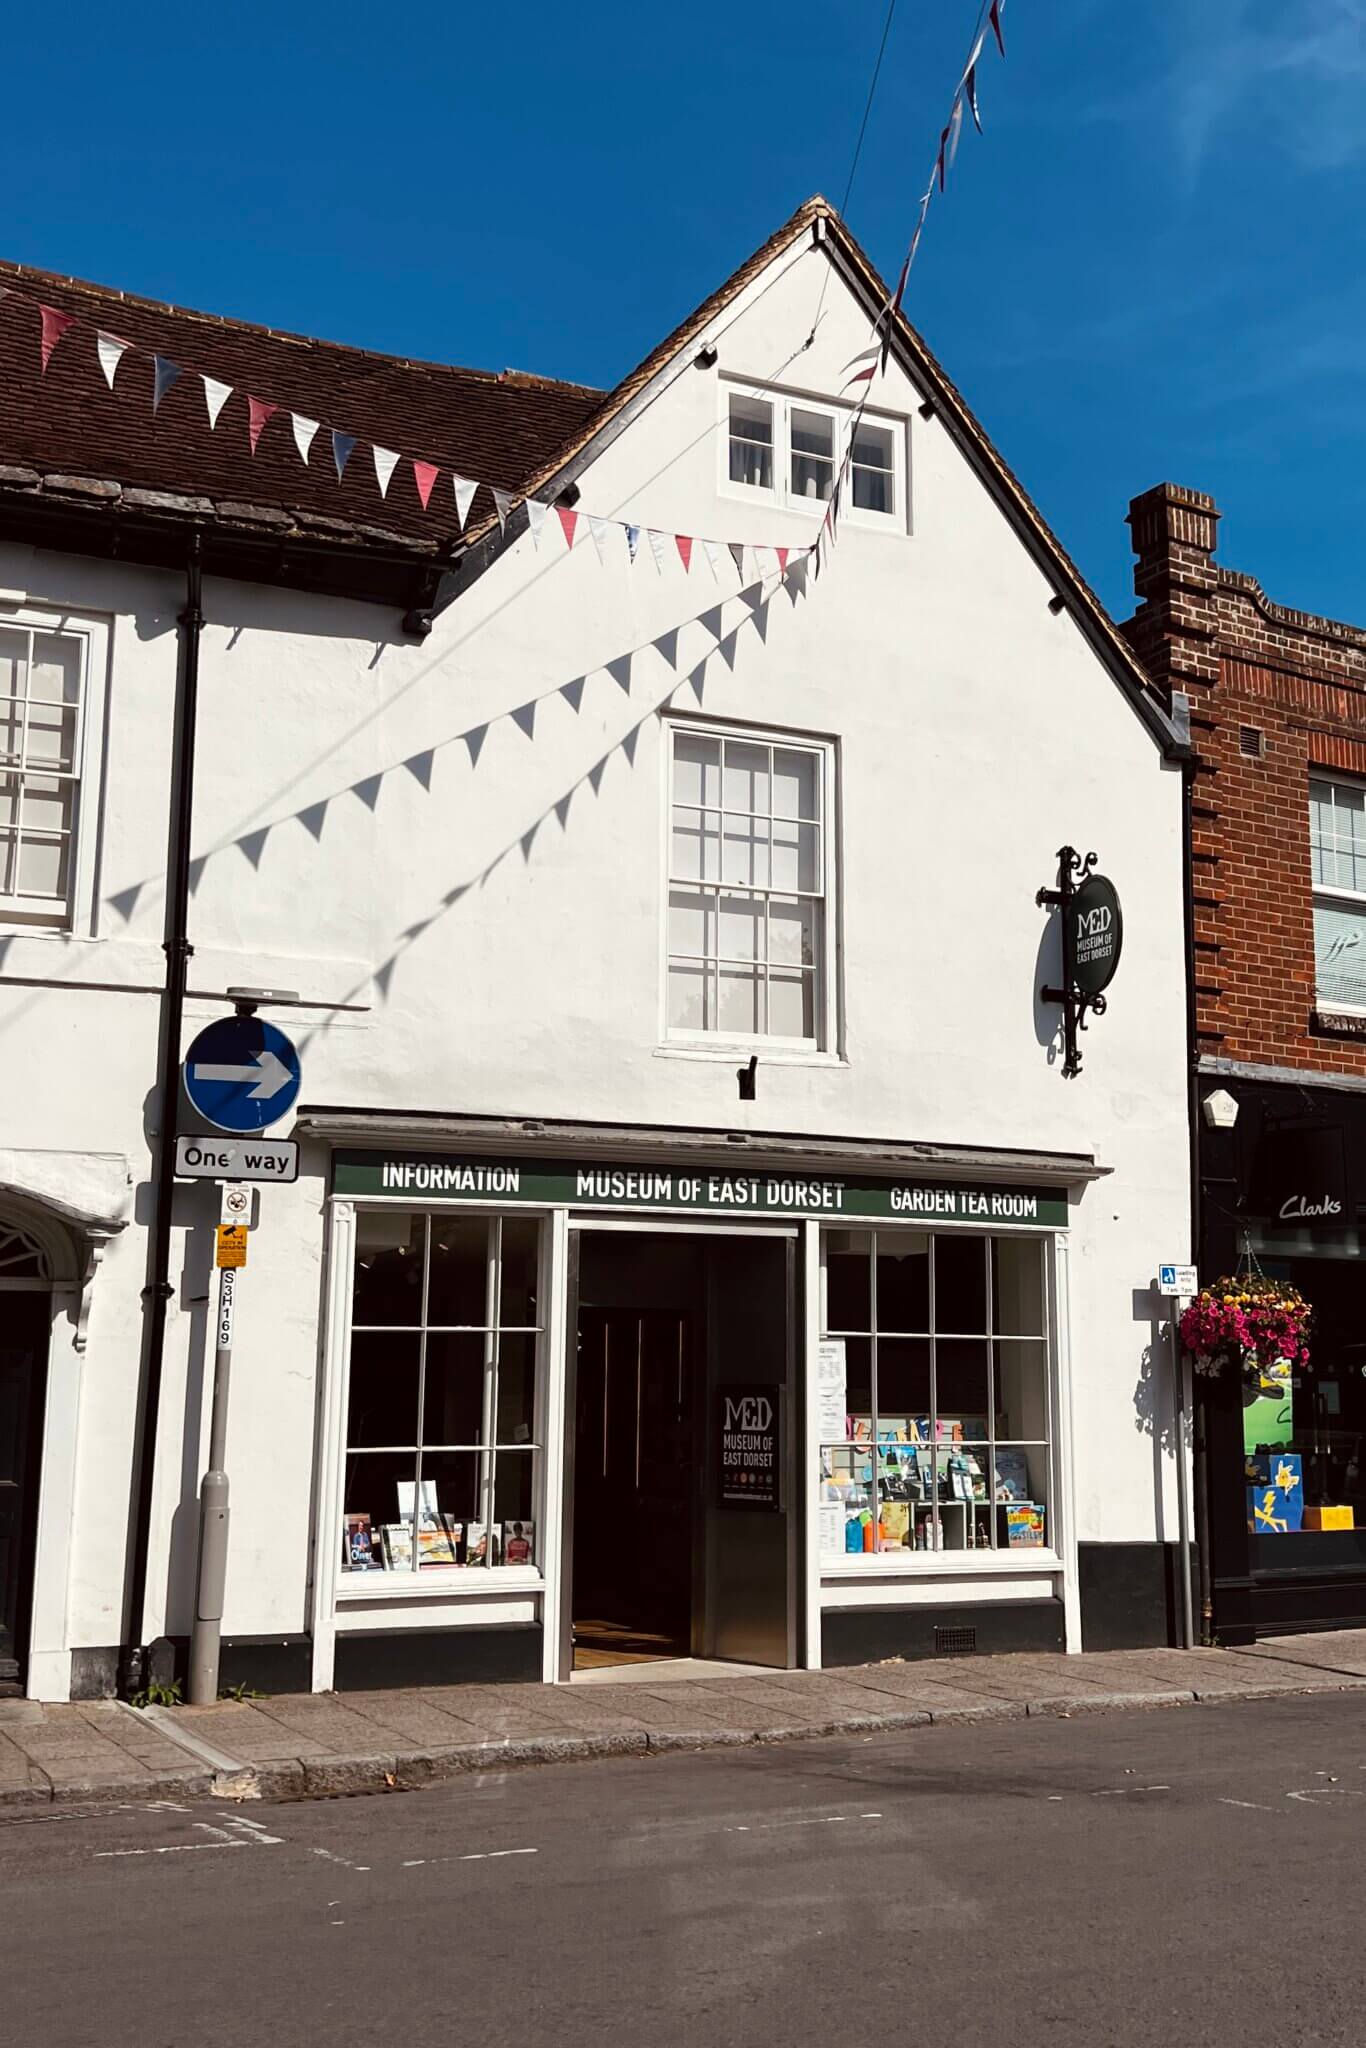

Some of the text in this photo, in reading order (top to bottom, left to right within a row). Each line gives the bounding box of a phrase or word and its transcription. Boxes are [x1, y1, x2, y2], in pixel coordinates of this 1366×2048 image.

[1077, 905, 1112, 938] MED
[1077, 933, 1112, 953] MUSEUM OF
[1077, 945, 1112, 964] EAST DORSET
[184, 1147, 289, 1174] One way
[382, 1162, 520, 1193] INFORMATION
[576, 1170, 845, 1208] MUSEUM OF EAST DORSET
[890, 1187, 1037, 1218] GARDEN TEA ROOM
[1279, 1195, 1342, 1219] Clarks
[221, 1272, 234, 1344] S3H169
[723, 1397, 773, 1431] MED
[723, 1434, 773, 1451] MUSEUM OF
[723, 1452, 773, 1467] EAST DORSET
